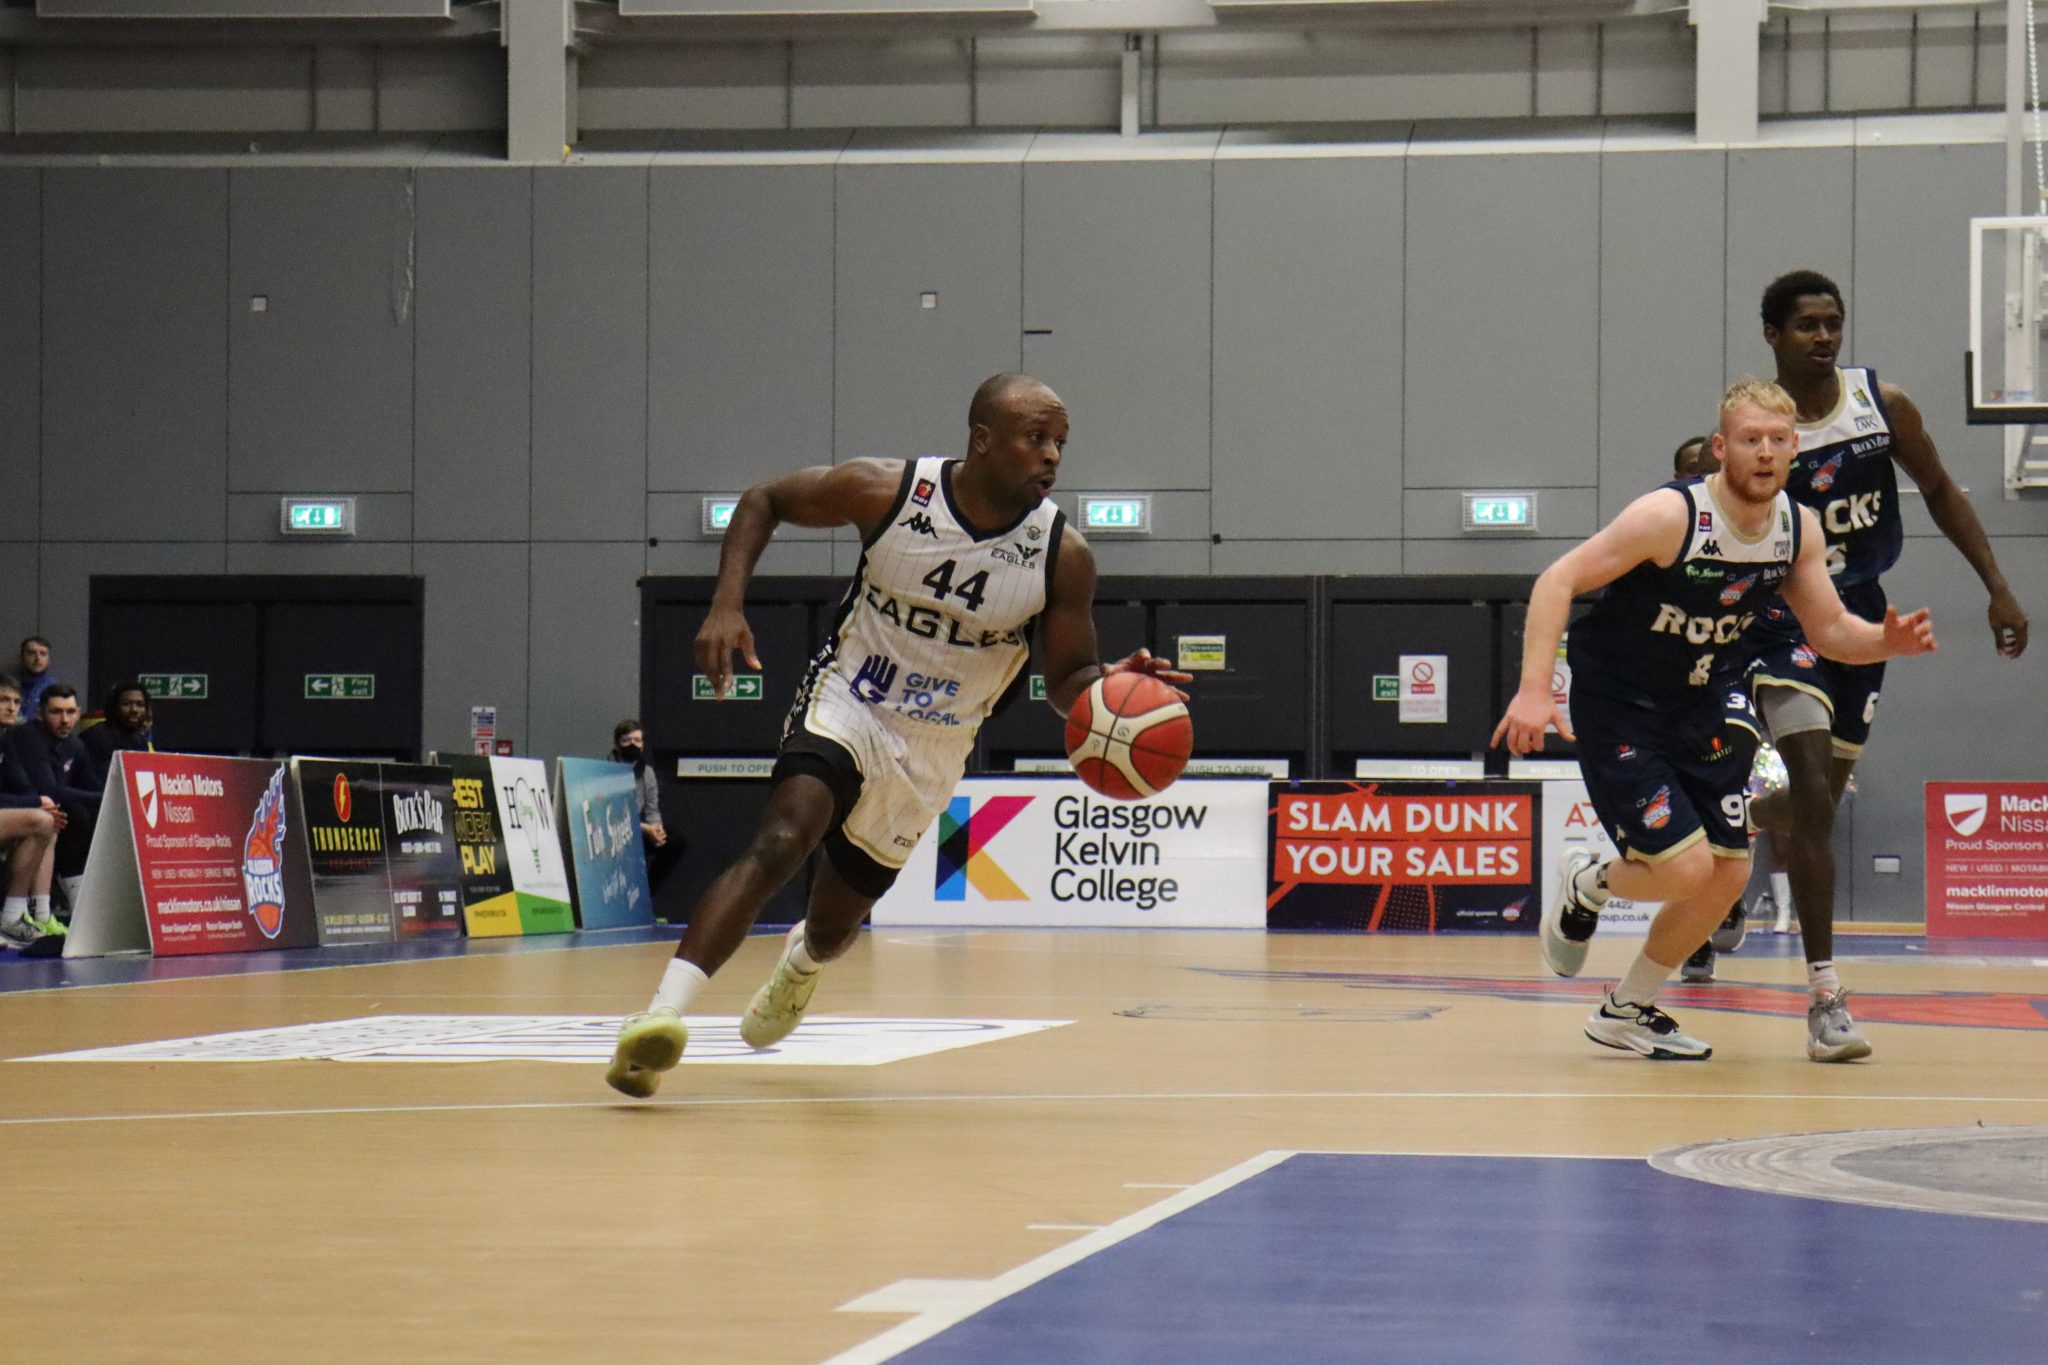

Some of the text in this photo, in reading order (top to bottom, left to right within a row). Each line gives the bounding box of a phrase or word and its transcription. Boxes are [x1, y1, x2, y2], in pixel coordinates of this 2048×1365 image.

[922, 559, 990, 612] 44
[351, 678, 369, 687] Fire
[351, 687, 368, 697] exit
[906, 672, 961, 697] GIVE
[1380, 679, 1399, 688] Fire
[902, 688, 933, 708] TO
[1380, 688, 1398, 698] exit
[698, 764, 727, 774] PUSH
[731, 764, 745, 774] TO
[1216, 765, 1232, 775] TO
[1234, 765, 1265, 775] OPEN
[1411, 765, 1461, 775] TO OPEN
[1530, 766, 1561, 775] PUSH
[159, 773, 224, 798] Macklin Motors
[163, 801, 195, 824] Nissan
[392, 789, 444, 836] BUCK'S BAR
[1054, 795, 1208, 838] Glasgow
[1288, 801, 1520, 833] SLAM DUNK
[146, 834, 232, 850] Proud Sponsors of Glasgow Rocks
[312, 826, 382, 852] THUNDERCAT
[1054, 832, 1161, 866] Kelvin
[1945, 839, 1983, 851] Proud
[1985, 839, 2044, 853] Sponsors
[459, 845, 497, 876] PLAY
[1285, 845, 1521, 877] YOUR SALES
[1945, 864, 1969, 872] NEW
[1976, 864, 2003, 873] USED
[246, 872, 282, 905] ROCKS
[1050, 868, 1179, 911] College
[1607, 901, 1634, 910] 4422
[1946, 902, 2046, 912] Nissan Glasgow Central
